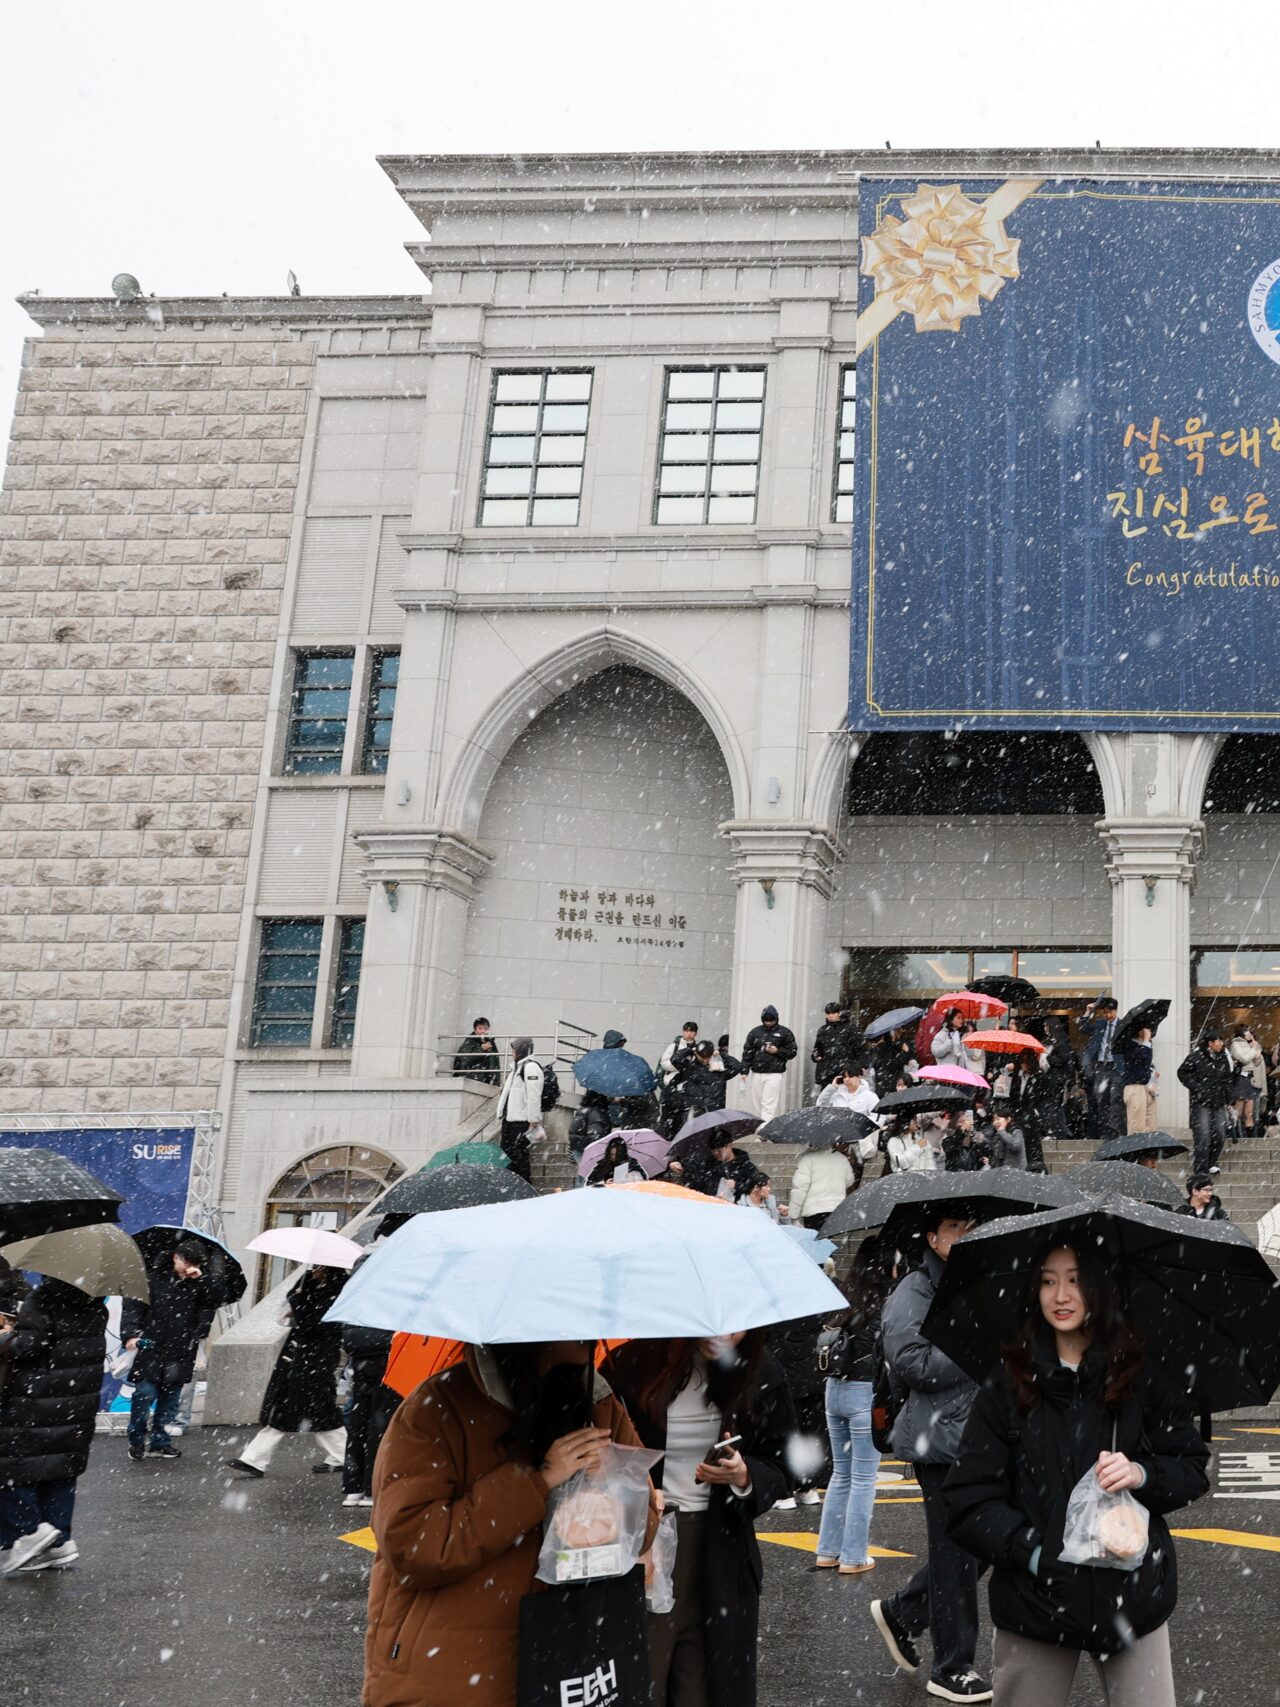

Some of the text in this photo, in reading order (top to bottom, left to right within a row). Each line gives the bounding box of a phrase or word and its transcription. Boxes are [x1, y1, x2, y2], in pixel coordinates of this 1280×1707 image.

[1106, 487, 1278, 539] 진심으로
[558, 888, 590, 904] 하늘과
[625, 893, 655, 908] 바다와
[632, 912, 662, 928] 만드신
[132, 1144, 156, 1160] SU
